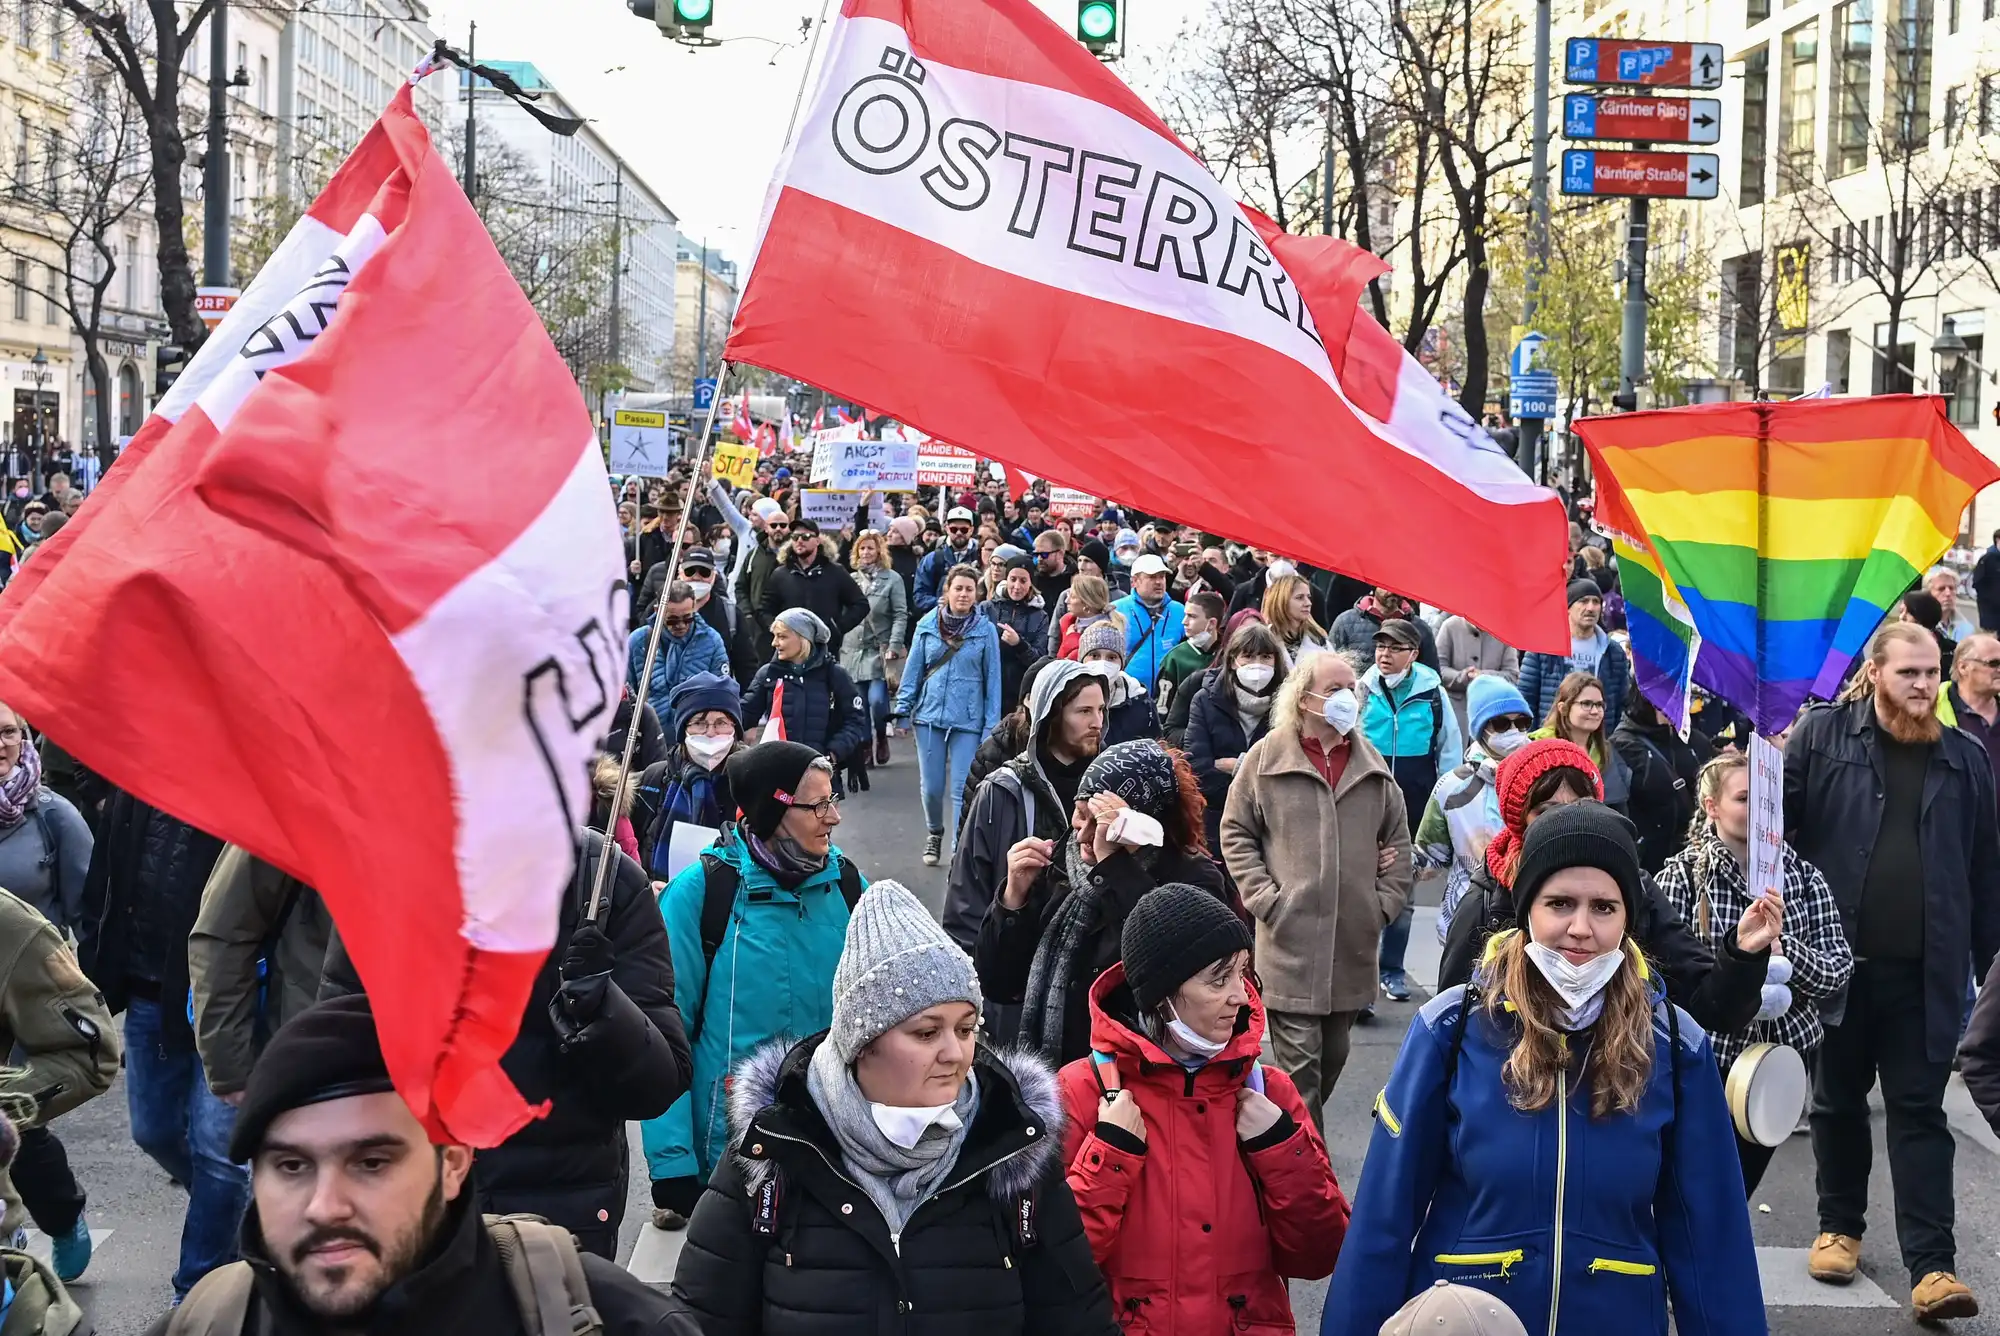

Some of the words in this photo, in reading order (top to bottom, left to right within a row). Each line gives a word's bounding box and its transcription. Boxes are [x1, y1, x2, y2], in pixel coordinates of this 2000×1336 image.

[1599, 100, 1655, 118] Kärntner
[1657, 102, 1688, 121] Ring
[1594, 166, 1645, 181] Kärntner
[1647, 167, 1686, 182] Straße
[832, 46, 1325, 352] ÖSTERR
[194, 297, 226, 309] ORF
[1523, 401, 1546, 413] 100
[624, 414, 656, 425] Passau
[844, 445, 886, 459] ANGST
[716, 454, 751, 476] STOP
[938, 461, 973, 469] unseren
[919, 472, 972, 485] KINDERN
